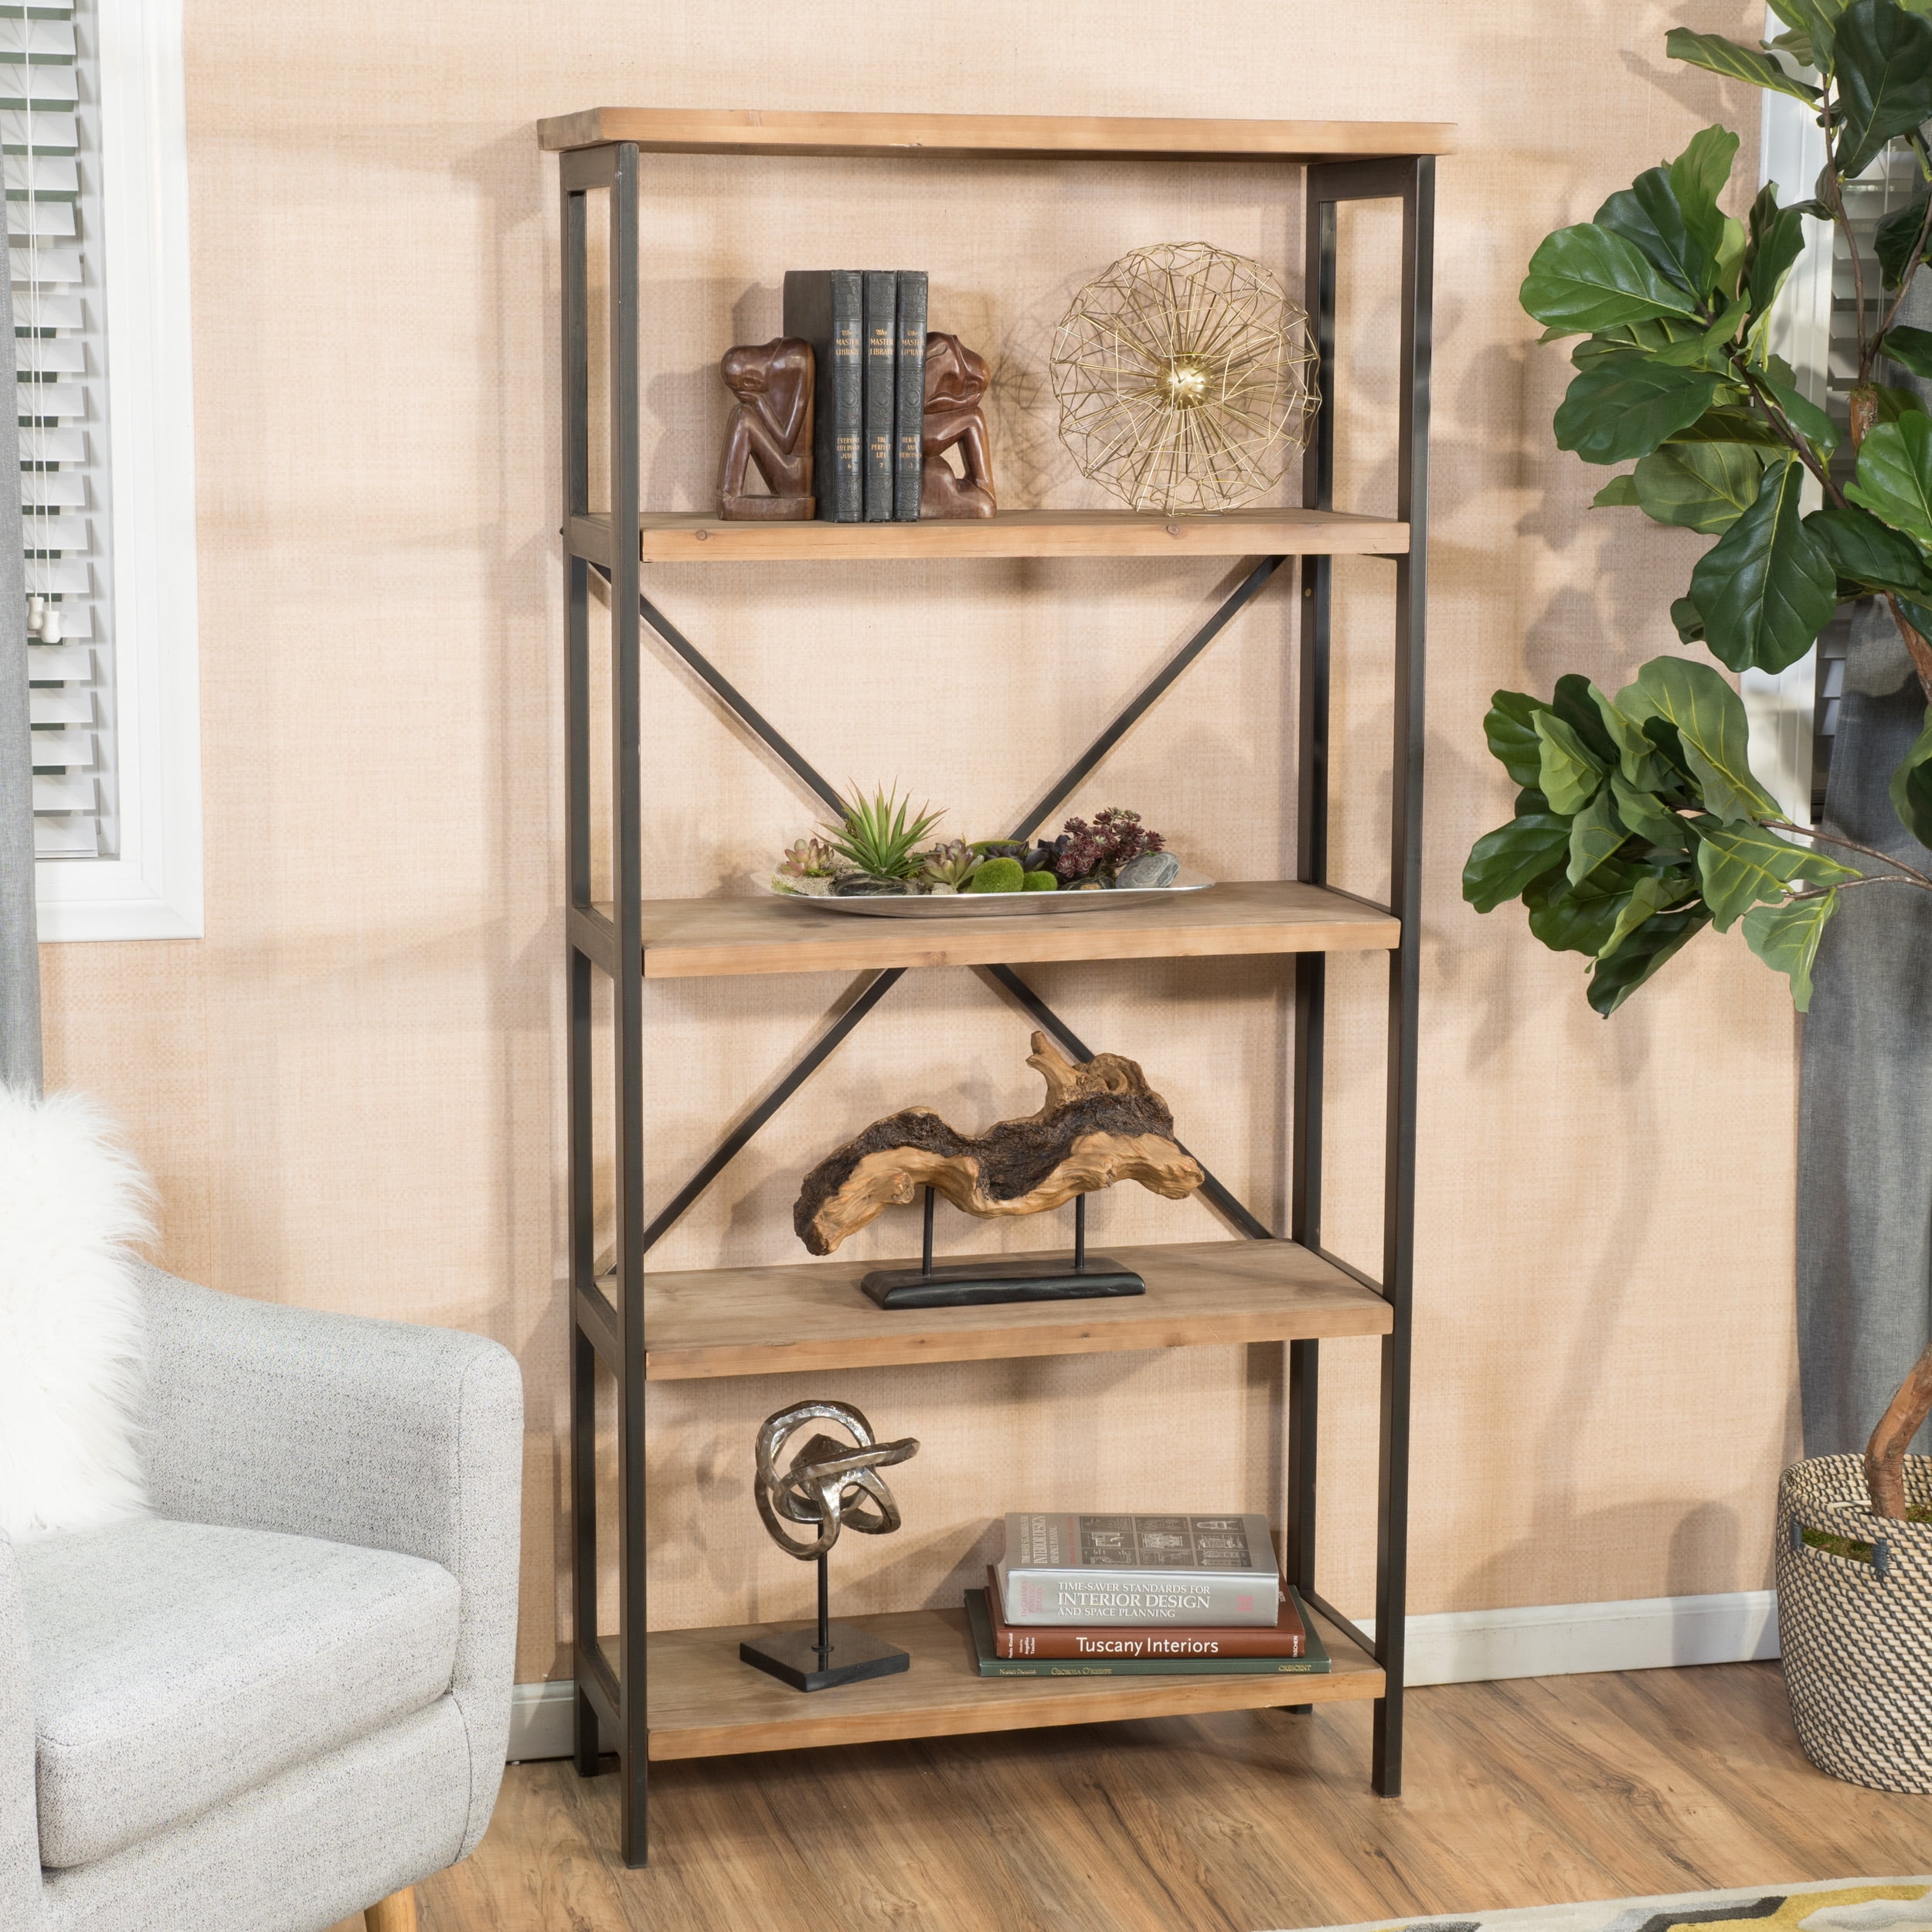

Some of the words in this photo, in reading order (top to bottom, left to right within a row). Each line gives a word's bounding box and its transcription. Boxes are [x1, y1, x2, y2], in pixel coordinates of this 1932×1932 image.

[1032, 1515, 1046, 1536] DESIGN
[1032, 1536, 1048, 1564] INTERIOR
[1056, 1581, 1120, 1592] TIME-SAVER
[1122, 1583, 1187, 1594] STANDARDS
[1189, 1585, 1211, 1594] FOR
[1056, 1592, 1142, 1607] INTERIOR
[1145, 1594, 1211, 1609] DESIGN
[1056, 1607, 1081, 1616] AND
[1084, 1607, 1116, 1617] SPACE
[1118, 1608, 1176, 1617] PLANNING
[1075, 1637, 1143, 1657] Tuscany
[1147, 1638, 1219, 1654] Interiors
